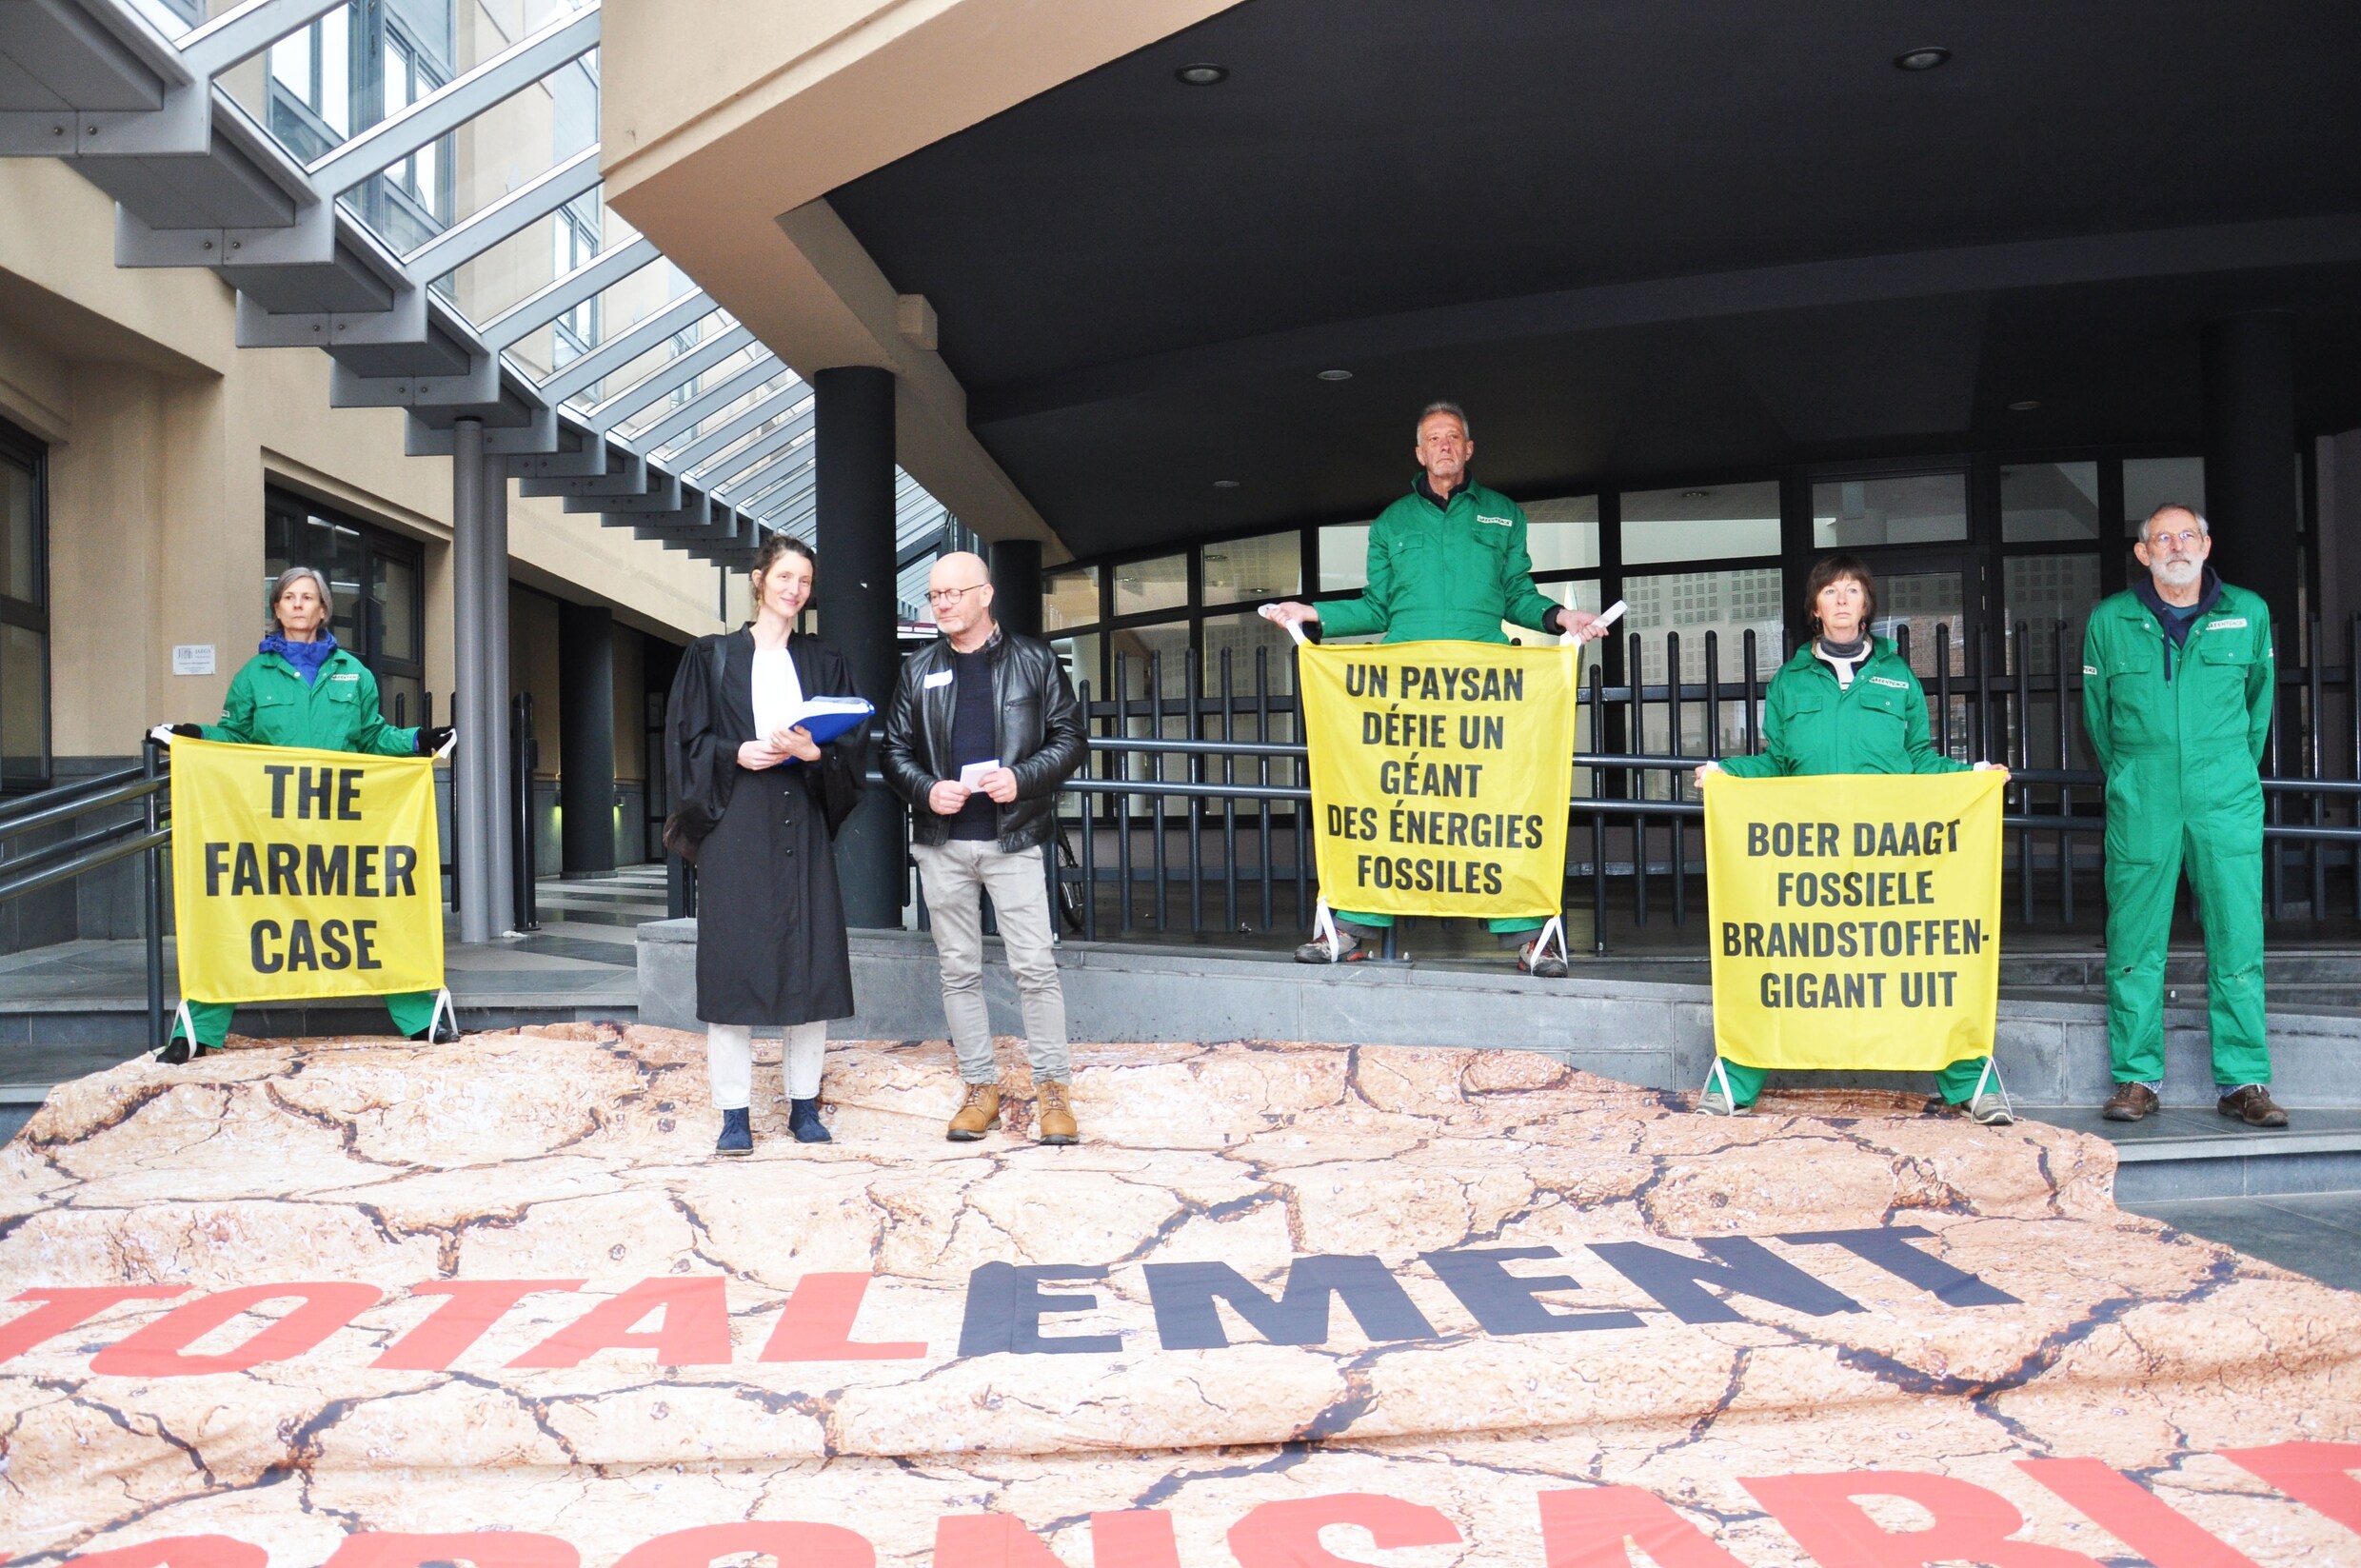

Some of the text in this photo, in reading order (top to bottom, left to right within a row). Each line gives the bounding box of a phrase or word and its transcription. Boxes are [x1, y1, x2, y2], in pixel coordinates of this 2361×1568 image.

[1345, 665, 1523, 701] UN PAYSAN
[1362, 703, 1503, 749] DÉFIE UN
[263, 765, 365, 821] THE
[1380, 752, 1483, 798] GÉANT
[1327, 799, 1543, 849] DES ÉNERGIES
[1748, 820, 1960, 857] BOER DAAGT
[205, 842, 417, 898] FARMER
[1358, 855, 1503, 895] FOSSILES
[1777, 870, 1934, 907] FOSSIELE
[250, 919, 383, 973] CASE
[1722, 920, 1991, 958] BRANDSTOFFEN-
[1760, 972, 1957, 1008] GIGANT UIT
[0, 1225, 2020, 1378] TOTALEMENT
